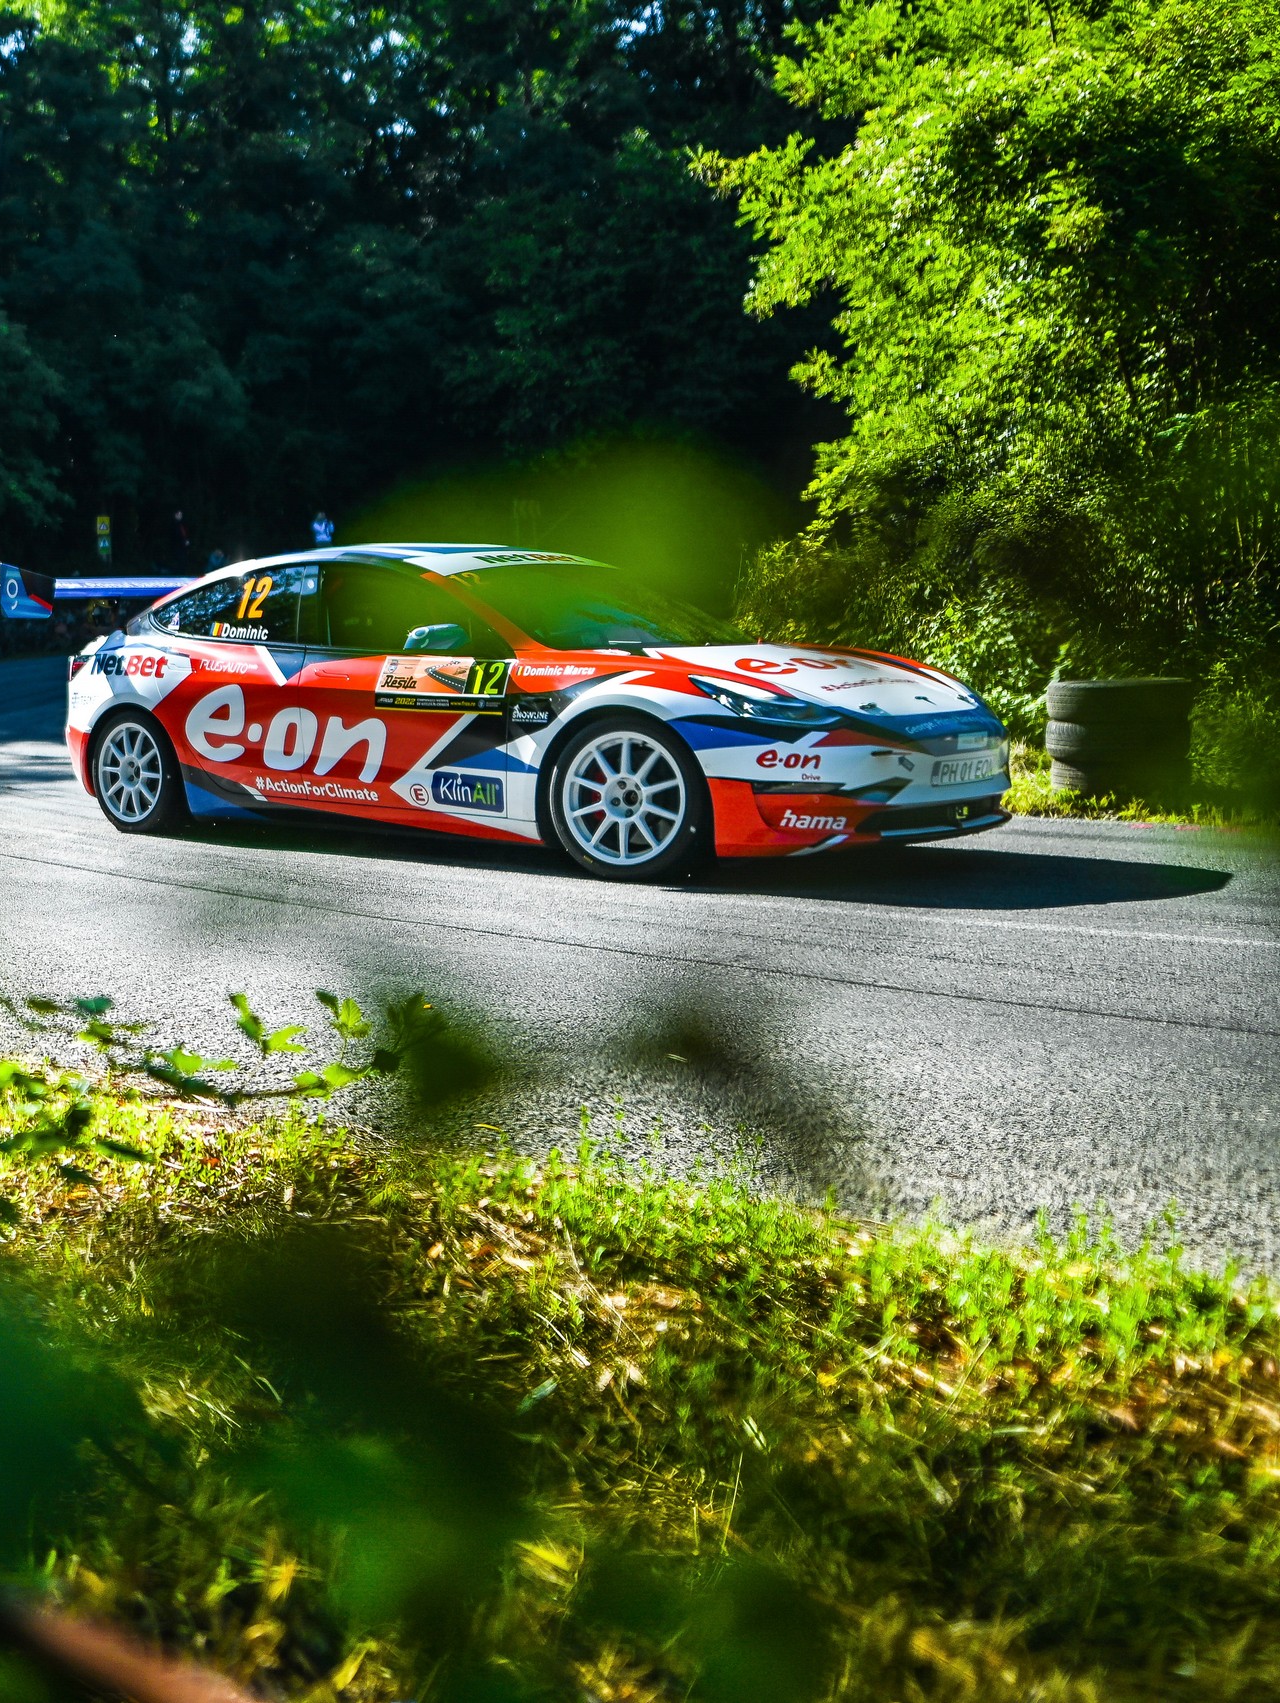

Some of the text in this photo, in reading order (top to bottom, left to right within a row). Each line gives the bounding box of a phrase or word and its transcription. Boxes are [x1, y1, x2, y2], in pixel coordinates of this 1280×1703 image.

[236, 576, 273, 619] 12
[221, 623, 269, 640] Dominic
[472, 662, 506, 695] 12
[523, 665, 596, 677] Dominic Marcu
[394, 697, 416, 706] 2022
[801, 773, 821, 781] Drive
[941, 762, 960, 783] PH
[960, 760, 973, 782] 01
[255, 776, 380, 802] #ActionForClimate
[412, 788, 426, 802] E
[780, 809, 848, 830] hama
